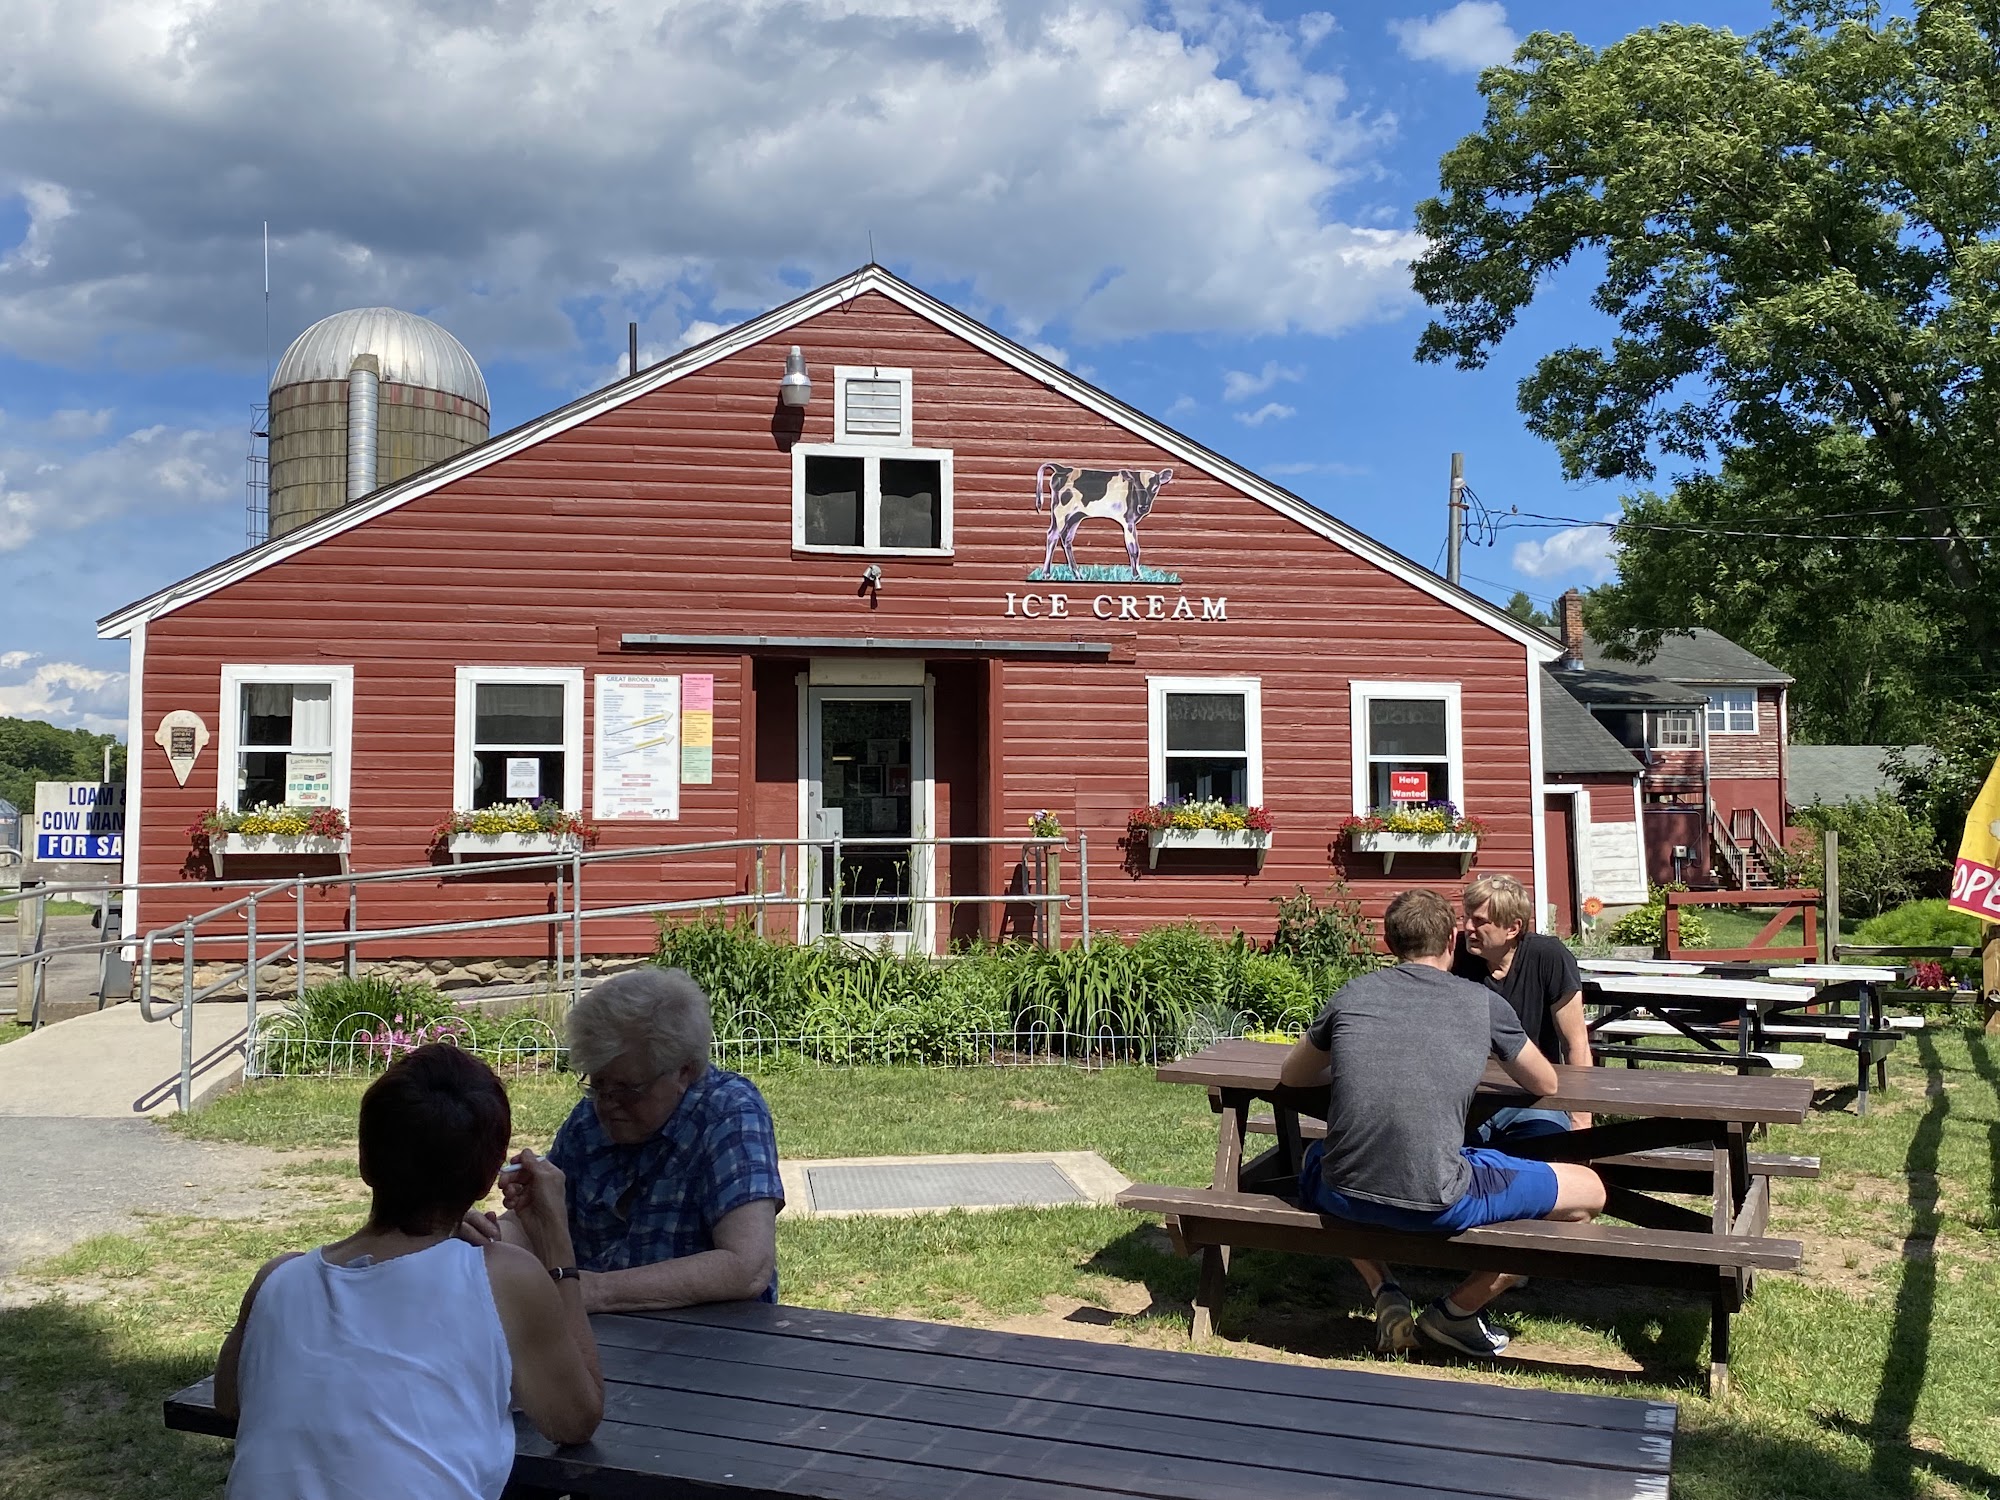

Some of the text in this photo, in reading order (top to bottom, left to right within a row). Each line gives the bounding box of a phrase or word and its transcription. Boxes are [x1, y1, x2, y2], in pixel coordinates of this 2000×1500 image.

[1004, 592, 1228, 621] ICE CREAM
[1399, 776, 1420, 785] Help
[69, 787, 113, 806] LOAM
[1393, 790, 1425, 798] Wanted
[42, 811, 80, 831] COW
[47, 835, 87, 856] FOR
